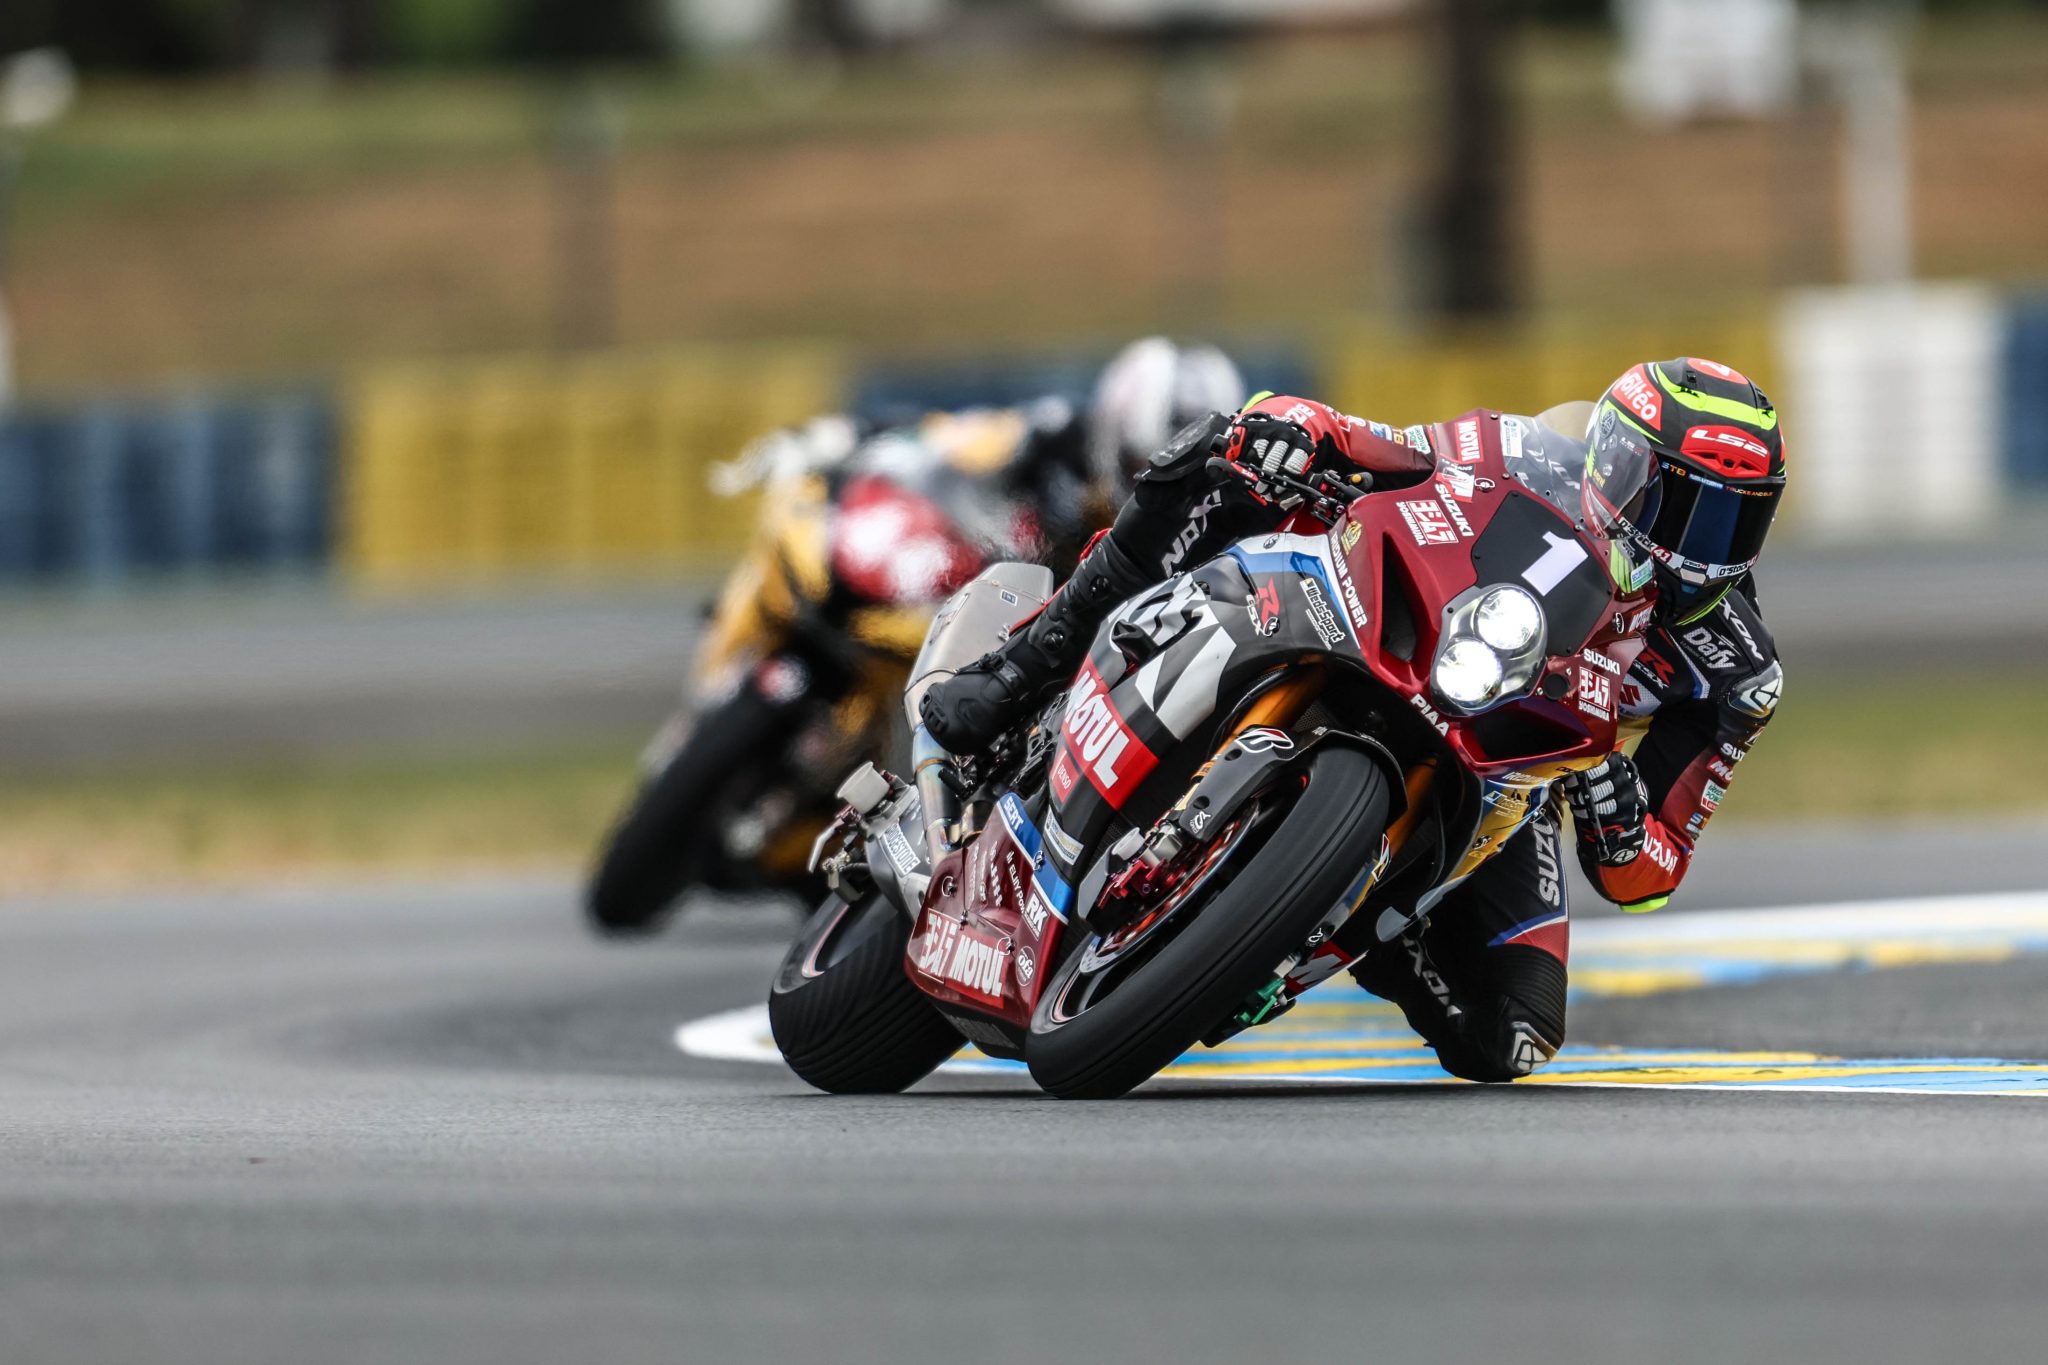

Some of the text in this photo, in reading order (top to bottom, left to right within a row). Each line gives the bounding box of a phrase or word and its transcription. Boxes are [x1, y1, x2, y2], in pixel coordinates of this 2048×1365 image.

[1691, 429, 1768, 458] LS2
[1396, 501, 1427, 546] YOSHIMURA
[1435, 484, 1474, 536] SUZUKI
[1330, 531, 1368, 629] IRIDIUM POWER
[1521, 531, 1588, 597] 1
[1583, 648, 1620, 675] SUZUKI
[1683, 626, 1736, 669] Dafy
[1064, 670, 1130, 789] MOTUL
[1410, 693, 1450, 737] PIAA
[1003, 796, 1024, 831] SERT
[1026, 892, 1047, 930] RK
[949, 934, 1004, 997] MOTUL
